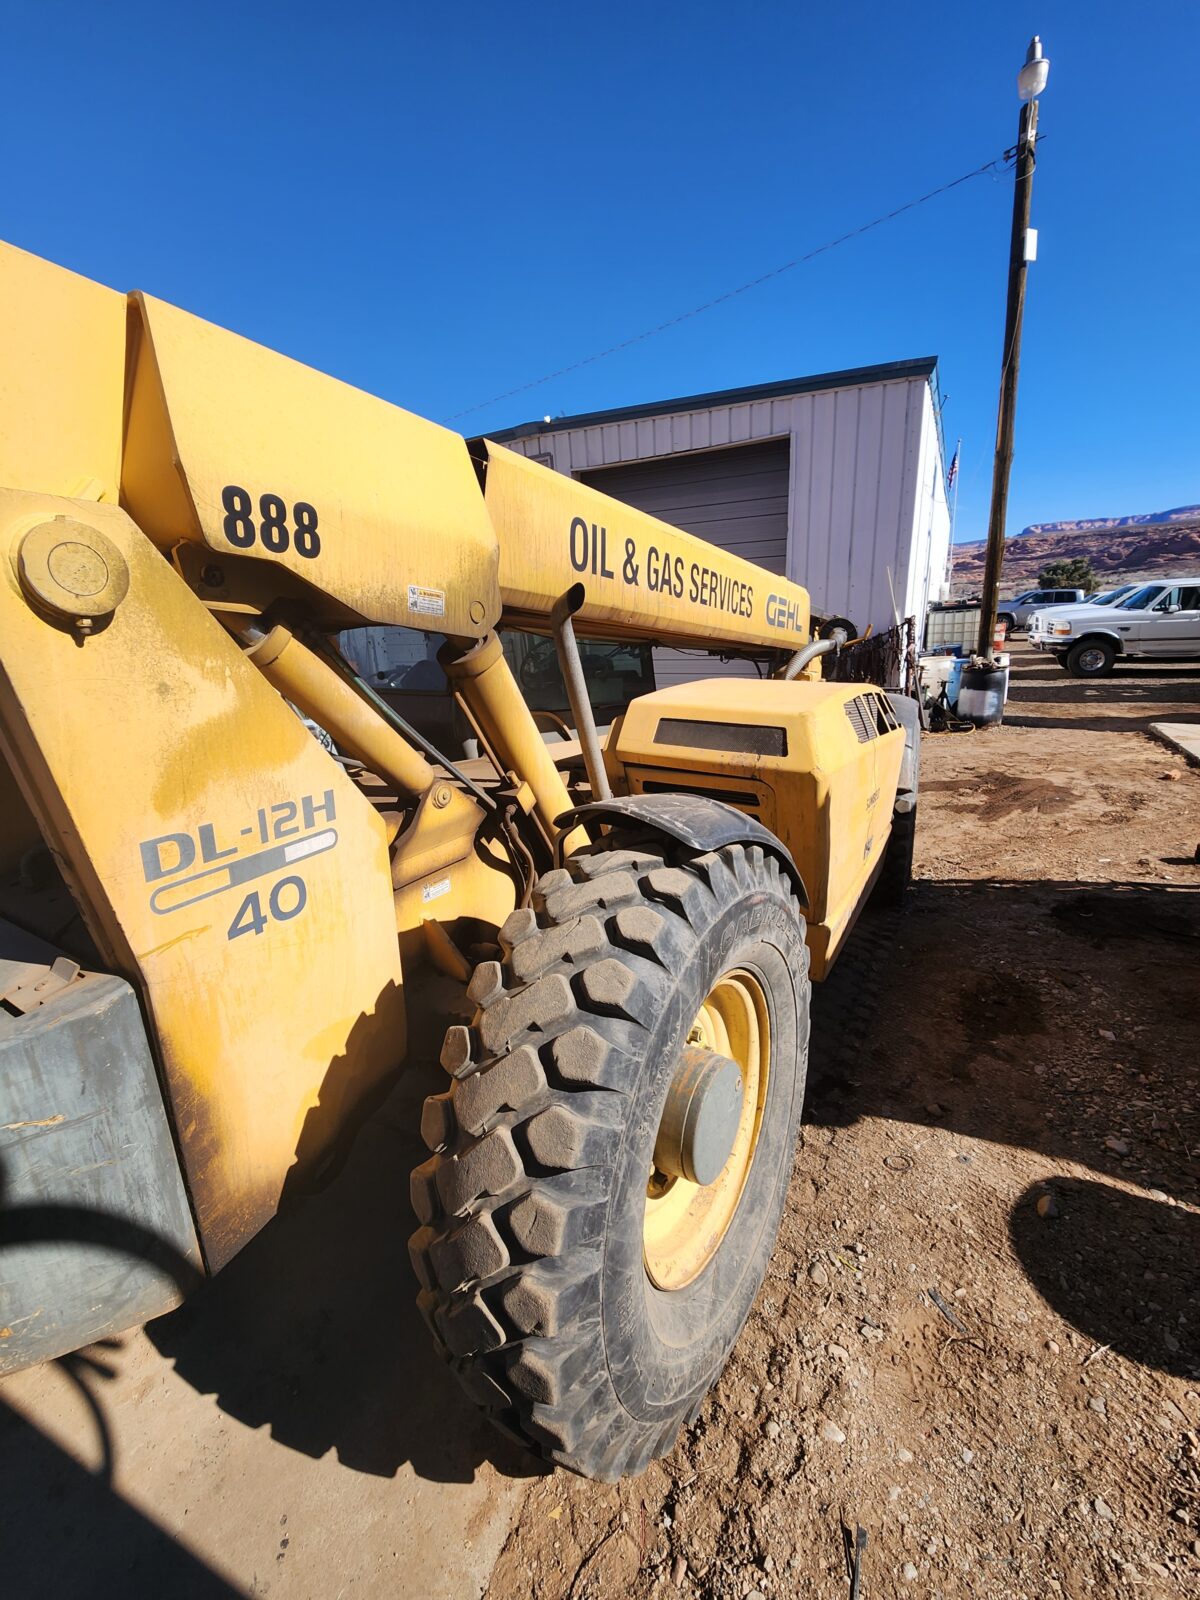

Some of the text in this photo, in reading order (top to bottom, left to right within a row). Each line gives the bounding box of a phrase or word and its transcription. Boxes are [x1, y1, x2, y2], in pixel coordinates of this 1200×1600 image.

[221, 485, 321, 559] 888
[570, 516, 754, 619] OIL & GAS SERVICES
[765, 593, 803, 633] GEHL
[139, 789, 337, 883] DL-12H
[227, 875, 308, 941] 40
